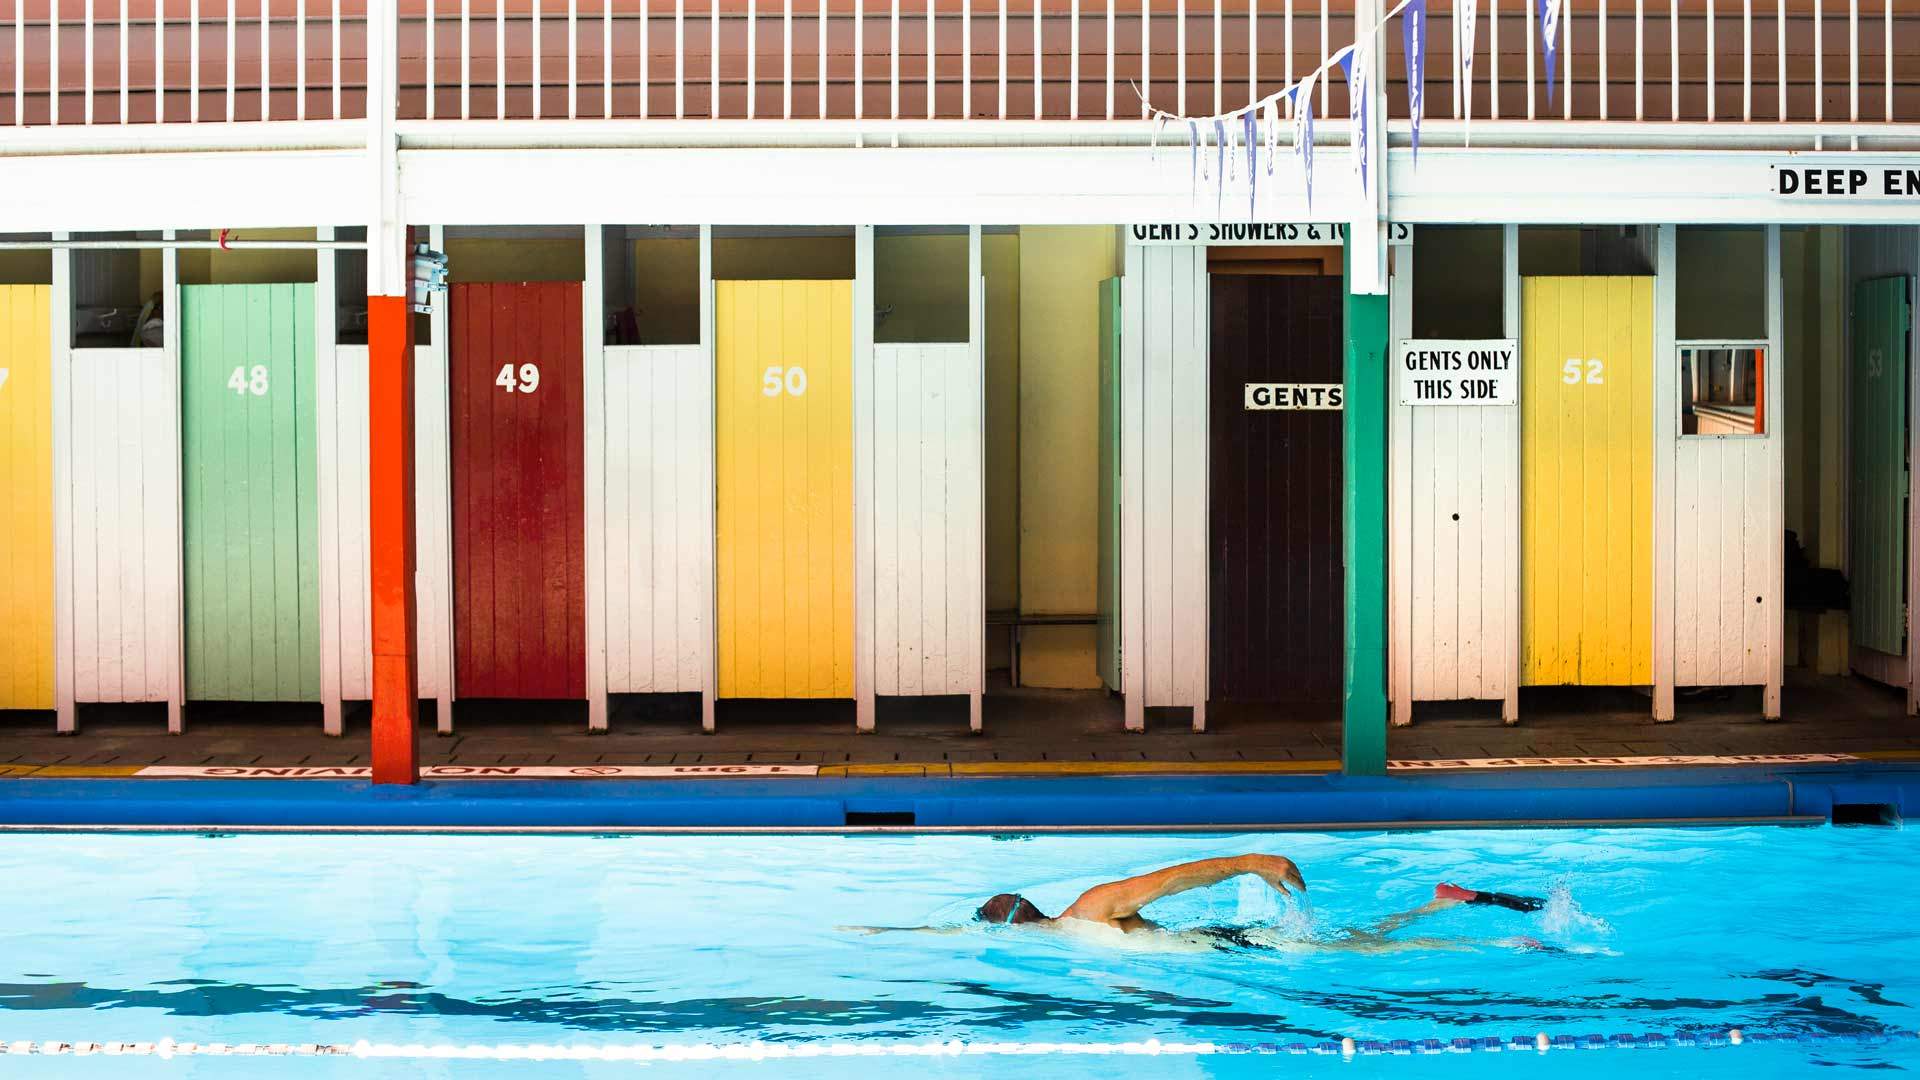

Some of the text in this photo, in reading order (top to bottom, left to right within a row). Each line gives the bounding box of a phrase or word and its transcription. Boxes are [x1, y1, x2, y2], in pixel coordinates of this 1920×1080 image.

[1779, 169, 1868, 195] DEEP
[1209, 223, 1299, 241] SHOWERS
[1306, 223, 1321, 241] &
[1405, 350, 1512, 371] GENTS ONLY
[1561, 358, 1604, 385] 52
[1868, 348, 1883, 378] 53
[226, 363, 270, 396] 48
[494, 362, 541, 394] 49
[761, 365, 808, 398] 50
[1413, 379, 1499, 400] THIS SIDE
[1252, 386, 1343, 407] GENTS
[203, 768, 373, 776] IVING
